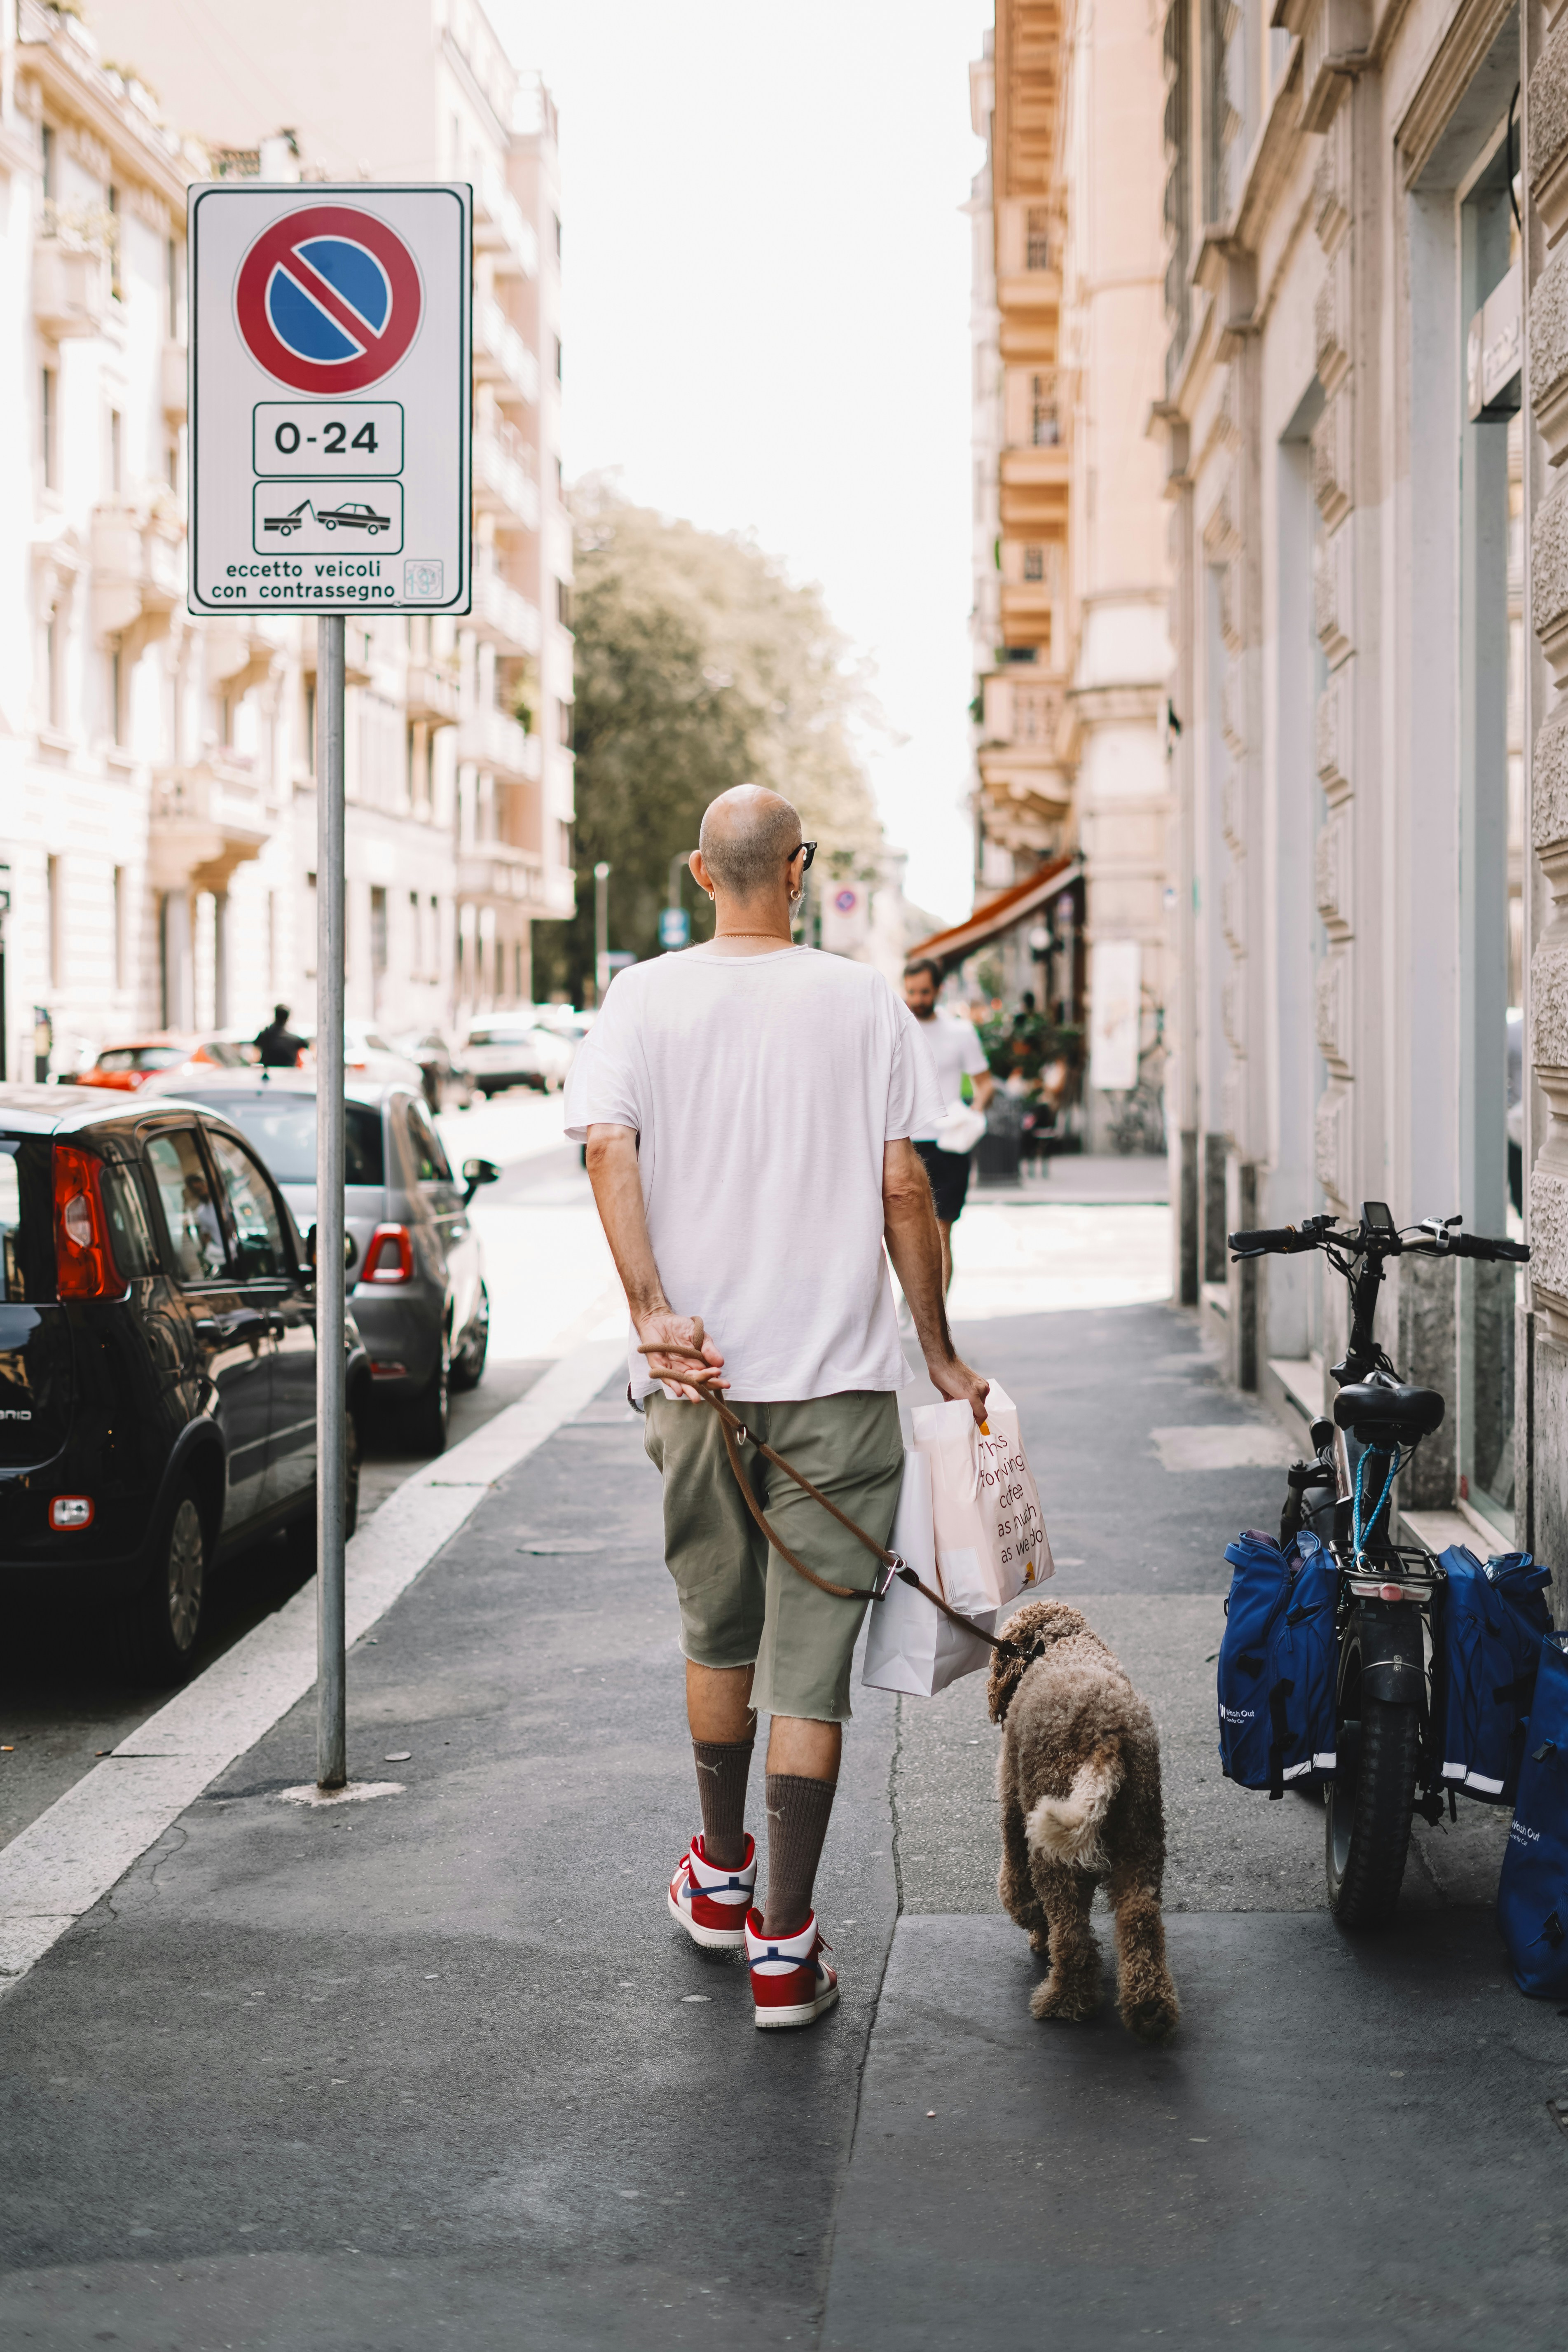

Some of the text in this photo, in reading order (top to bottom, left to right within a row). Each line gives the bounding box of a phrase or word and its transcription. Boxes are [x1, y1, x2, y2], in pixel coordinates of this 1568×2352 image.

[275, 421, 378, 454] 0-24
[226, 560, 381, 577] eccetto veicoli
[212, 582, 395, 601] con contrassegno
[998, 1521, 1011, 1537] as
[1001, 1528, 1043, 1563] as we do
[1226, 1708, 1240, 1717] Wash
[1512, 1818, 1540, 1842] Wash Out
